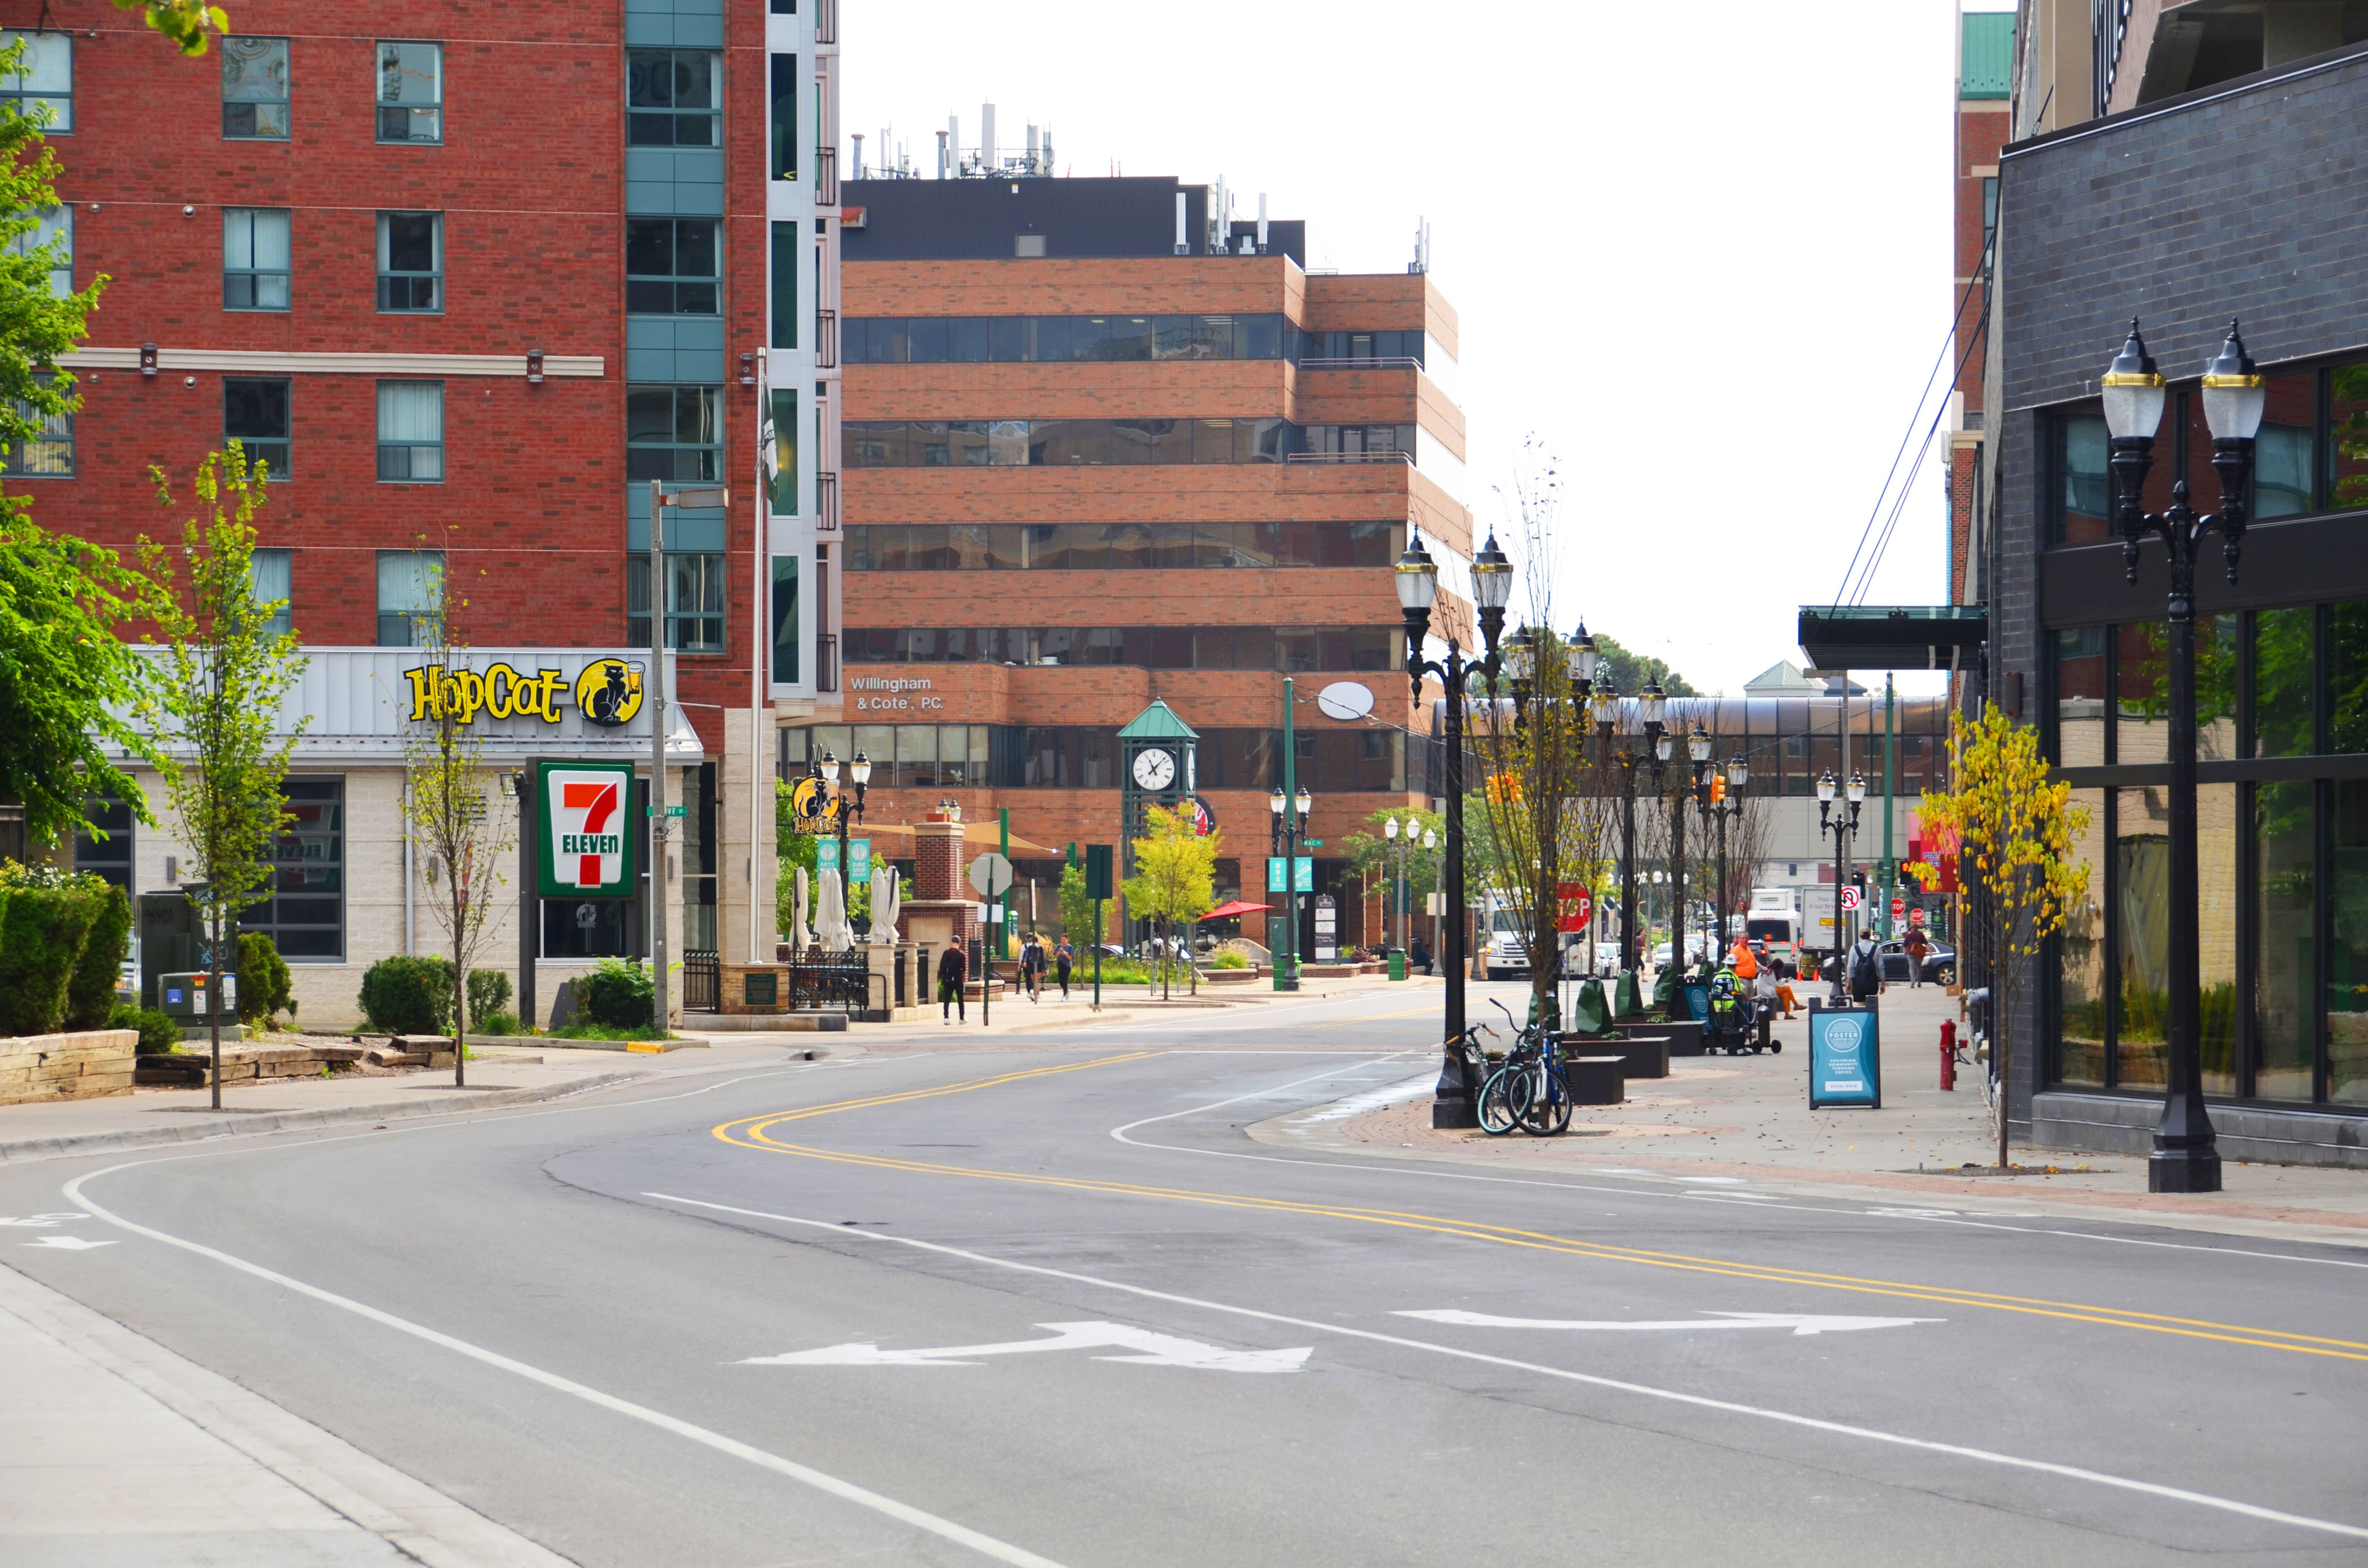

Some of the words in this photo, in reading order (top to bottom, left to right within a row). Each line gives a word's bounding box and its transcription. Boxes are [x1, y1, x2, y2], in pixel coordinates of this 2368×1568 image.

[403, 663, 569, 724] HopCat
[851, 678, 931, 692] Willingham
[857, 697, 868, 709] &
[921, 697, 943, 709] P.C.
[794, 817, 839, 834] HopCat
[1558, 898, 1591, 917] TOP
